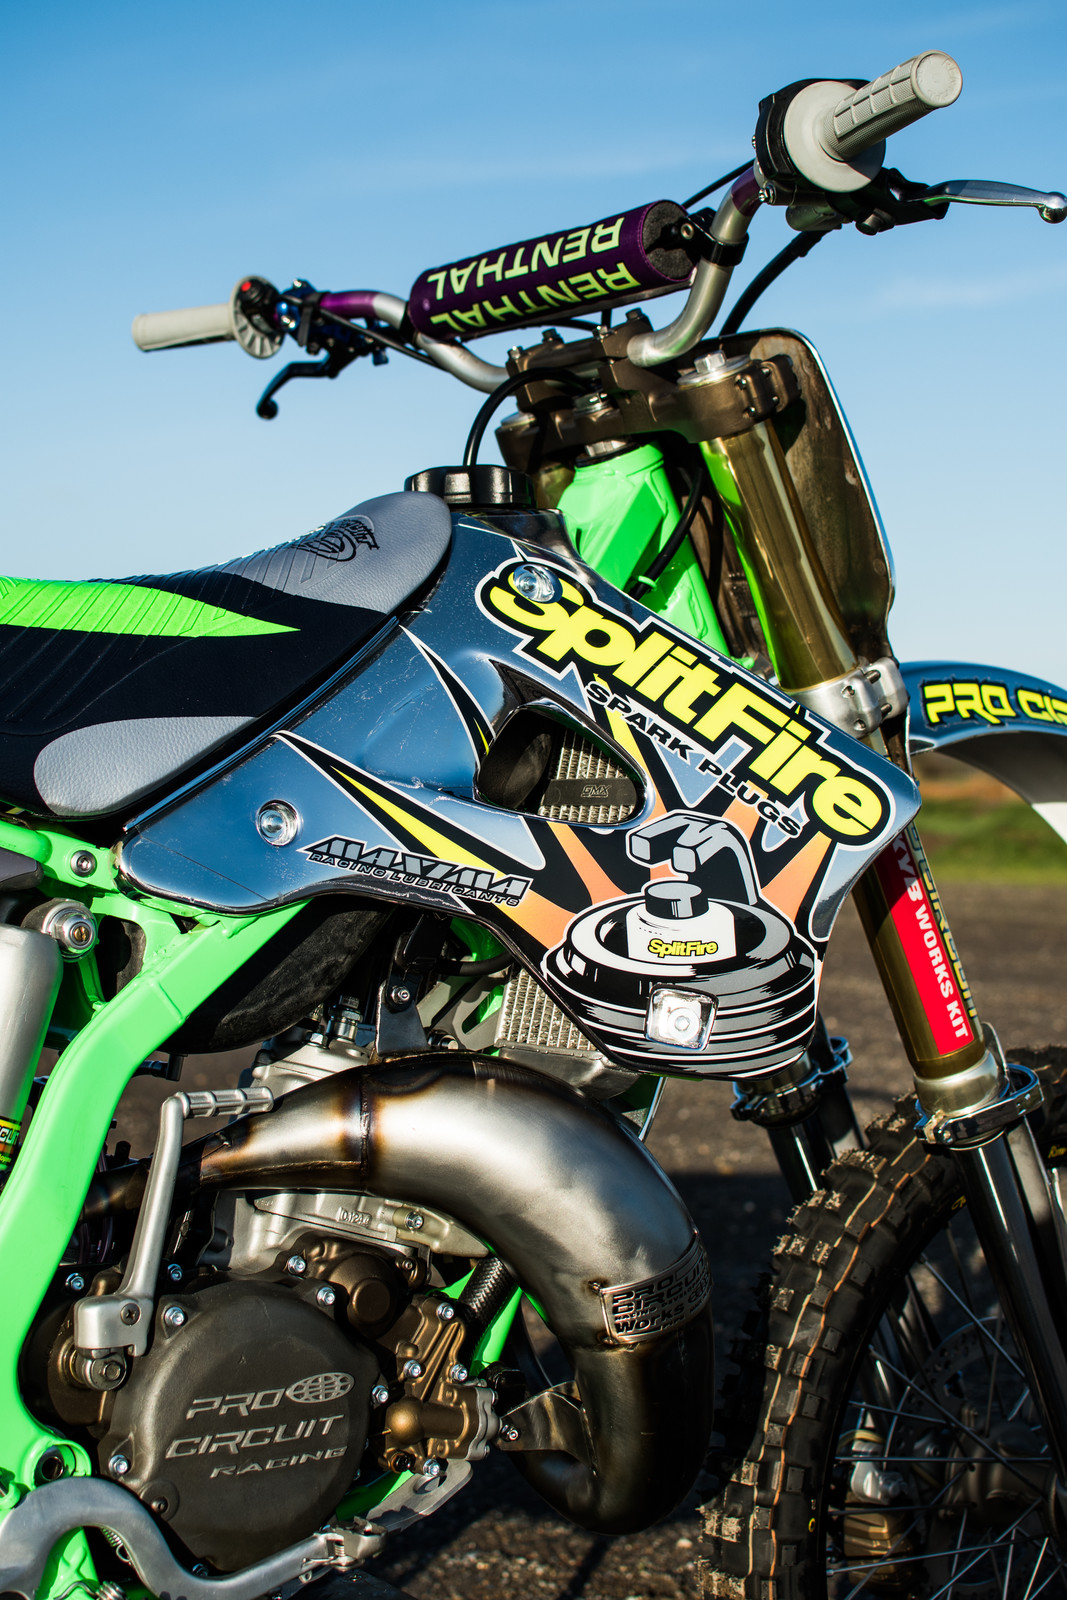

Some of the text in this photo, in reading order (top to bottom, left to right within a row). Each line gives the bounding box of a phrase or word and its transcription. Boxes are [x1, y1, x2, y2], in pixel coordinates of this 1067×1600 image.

[427, 216, 625, 300] RENTHAL
[430, 261, 642, 333] RENTHAL
[487, 567, 885, 838] SplitFire
[923, 682, 1017, 725] PRO
[585, 681, 802, 838] SPARK PLUGS
[304, 836, 531, 898] MAXIMA
[309, 852, 523, 907] RACING LUBRICANTS
[648, 938, 718, 958] SplitFire
[892, 832, 924, 902] KYB
[914, 903, 954, 999] WORKS
[946, 999, 969, 1038] KIT
[612, 1275, 674, 1303] PRO
[186, 1388, 286, 1420] PRO
[165, 1414, 345, 1459] CIRCUIT
[210, 1446, 348, 1479] RACING
